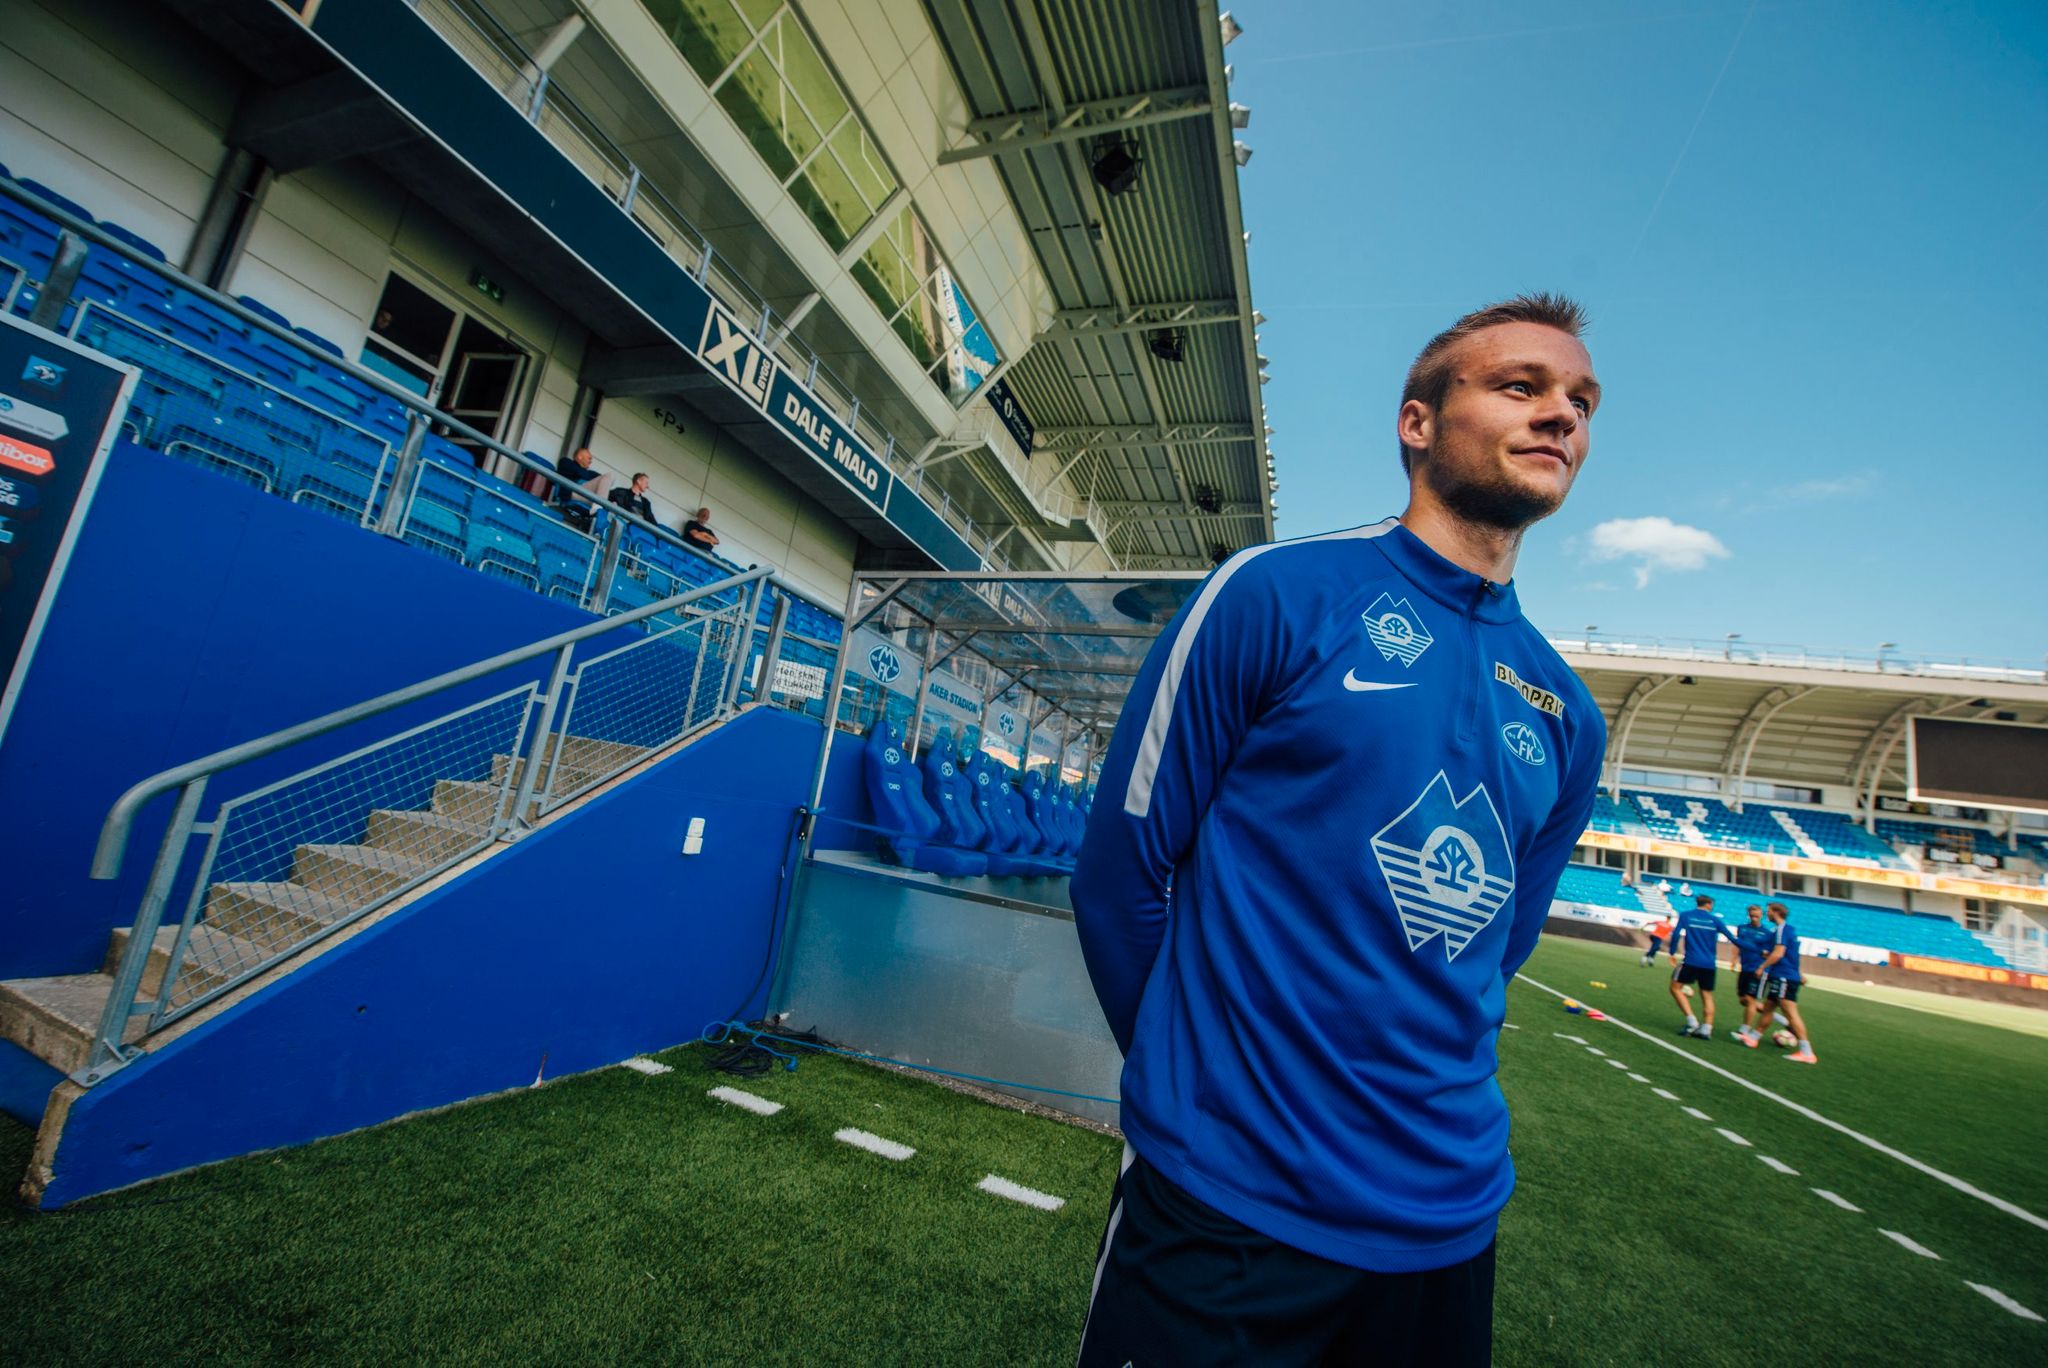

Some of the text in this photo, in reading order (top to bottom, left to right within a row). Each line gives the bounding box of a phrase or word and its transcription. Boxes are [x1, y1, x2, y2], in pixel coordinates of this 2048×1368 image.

[703, 311, 771, 404] XL BYGG
[783, 391, 878, 491] DALE MALO
[928, 683, 979, 714] AKER STADION
